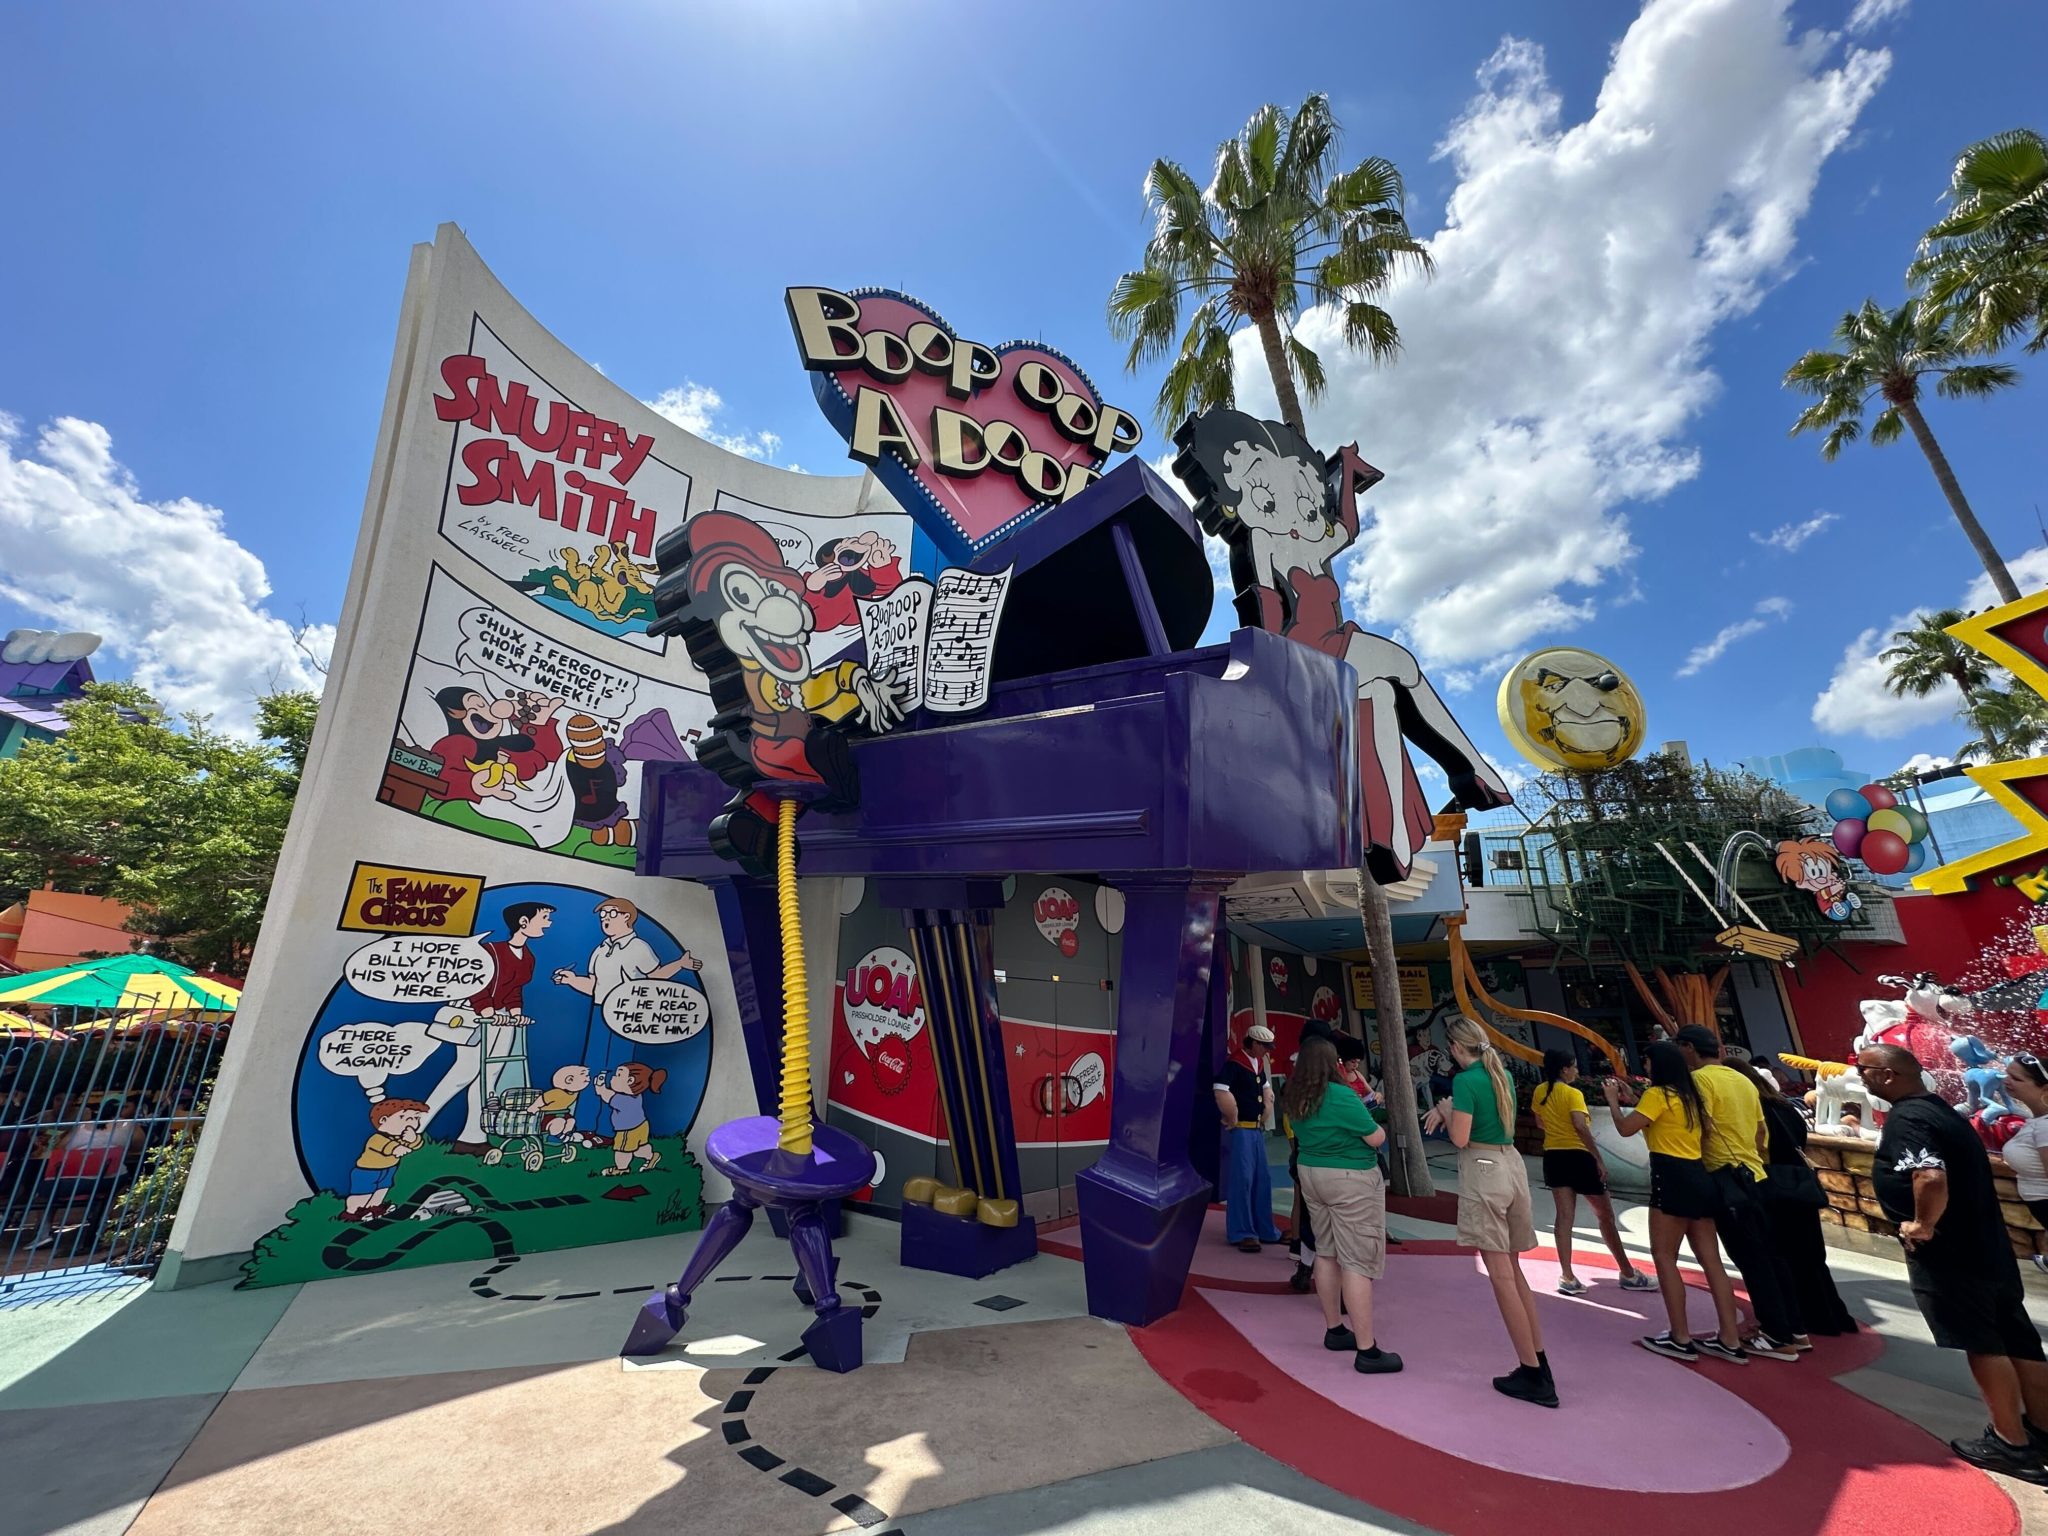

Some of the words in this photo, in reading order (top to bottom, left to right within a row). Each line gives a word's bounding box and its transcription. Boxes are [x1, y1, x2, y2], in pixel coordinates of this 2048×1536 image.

[433, 354, 655, 486] SNUFFY
[848, 384, 921, 468] A
[457, 520, 541, 562] LASSWELL
[496, 526, 529, 545] FRED
[476, 613, 526, 648] SHUX,
[534, 641, 544, 653] I
[479, 630, 524, 659] CHOIR
[528, 655, 597, 692] PRACTICE
[600, 686, 613, 699] IS
[482, 647, 531, 677] NEXT
[386, 877, 468, 907] FAMILY
[360, 897, 450, 927] CIRCUS
[391, 941, 402, 953] I
[411, 942, 461, 955] HOPE
[368, 954, 423, 967] BILLY
[427, 956, 484, 971] FINDS
[352, 968, 386, 982] HIS
[391, 970, 431, 982] WAY
[436, 970, 486, 986] BACK
[393, 984, 451, 998] HERE.
[631, 986, 649, 997] HE
[656, 987, 689, 998] WILL
[616, 998, 629, 1009] IF
[636, 1000, 654, 1009] HE
[660, 1000, 697, 1011] READ
[613, 1010, 643, 1022] THE
[651, 1013, 688, 1023] NOTE
[693, 1014, 699, 1024] I
[851, 1010, 887, 1023] PASSHOLDER
[887, 1018, 911, 1032] LOUNGE
[338, 1029, 397, 1042] THERE
[622, 1024, 659, 1035] GAVE
[665, 1026, 693, 1035] HIM.
[326, 1042, 353, 1054] HE
[362, 1043, 413, 1056] GOES
[335, 1056, 403, 1069] AGAIN!
